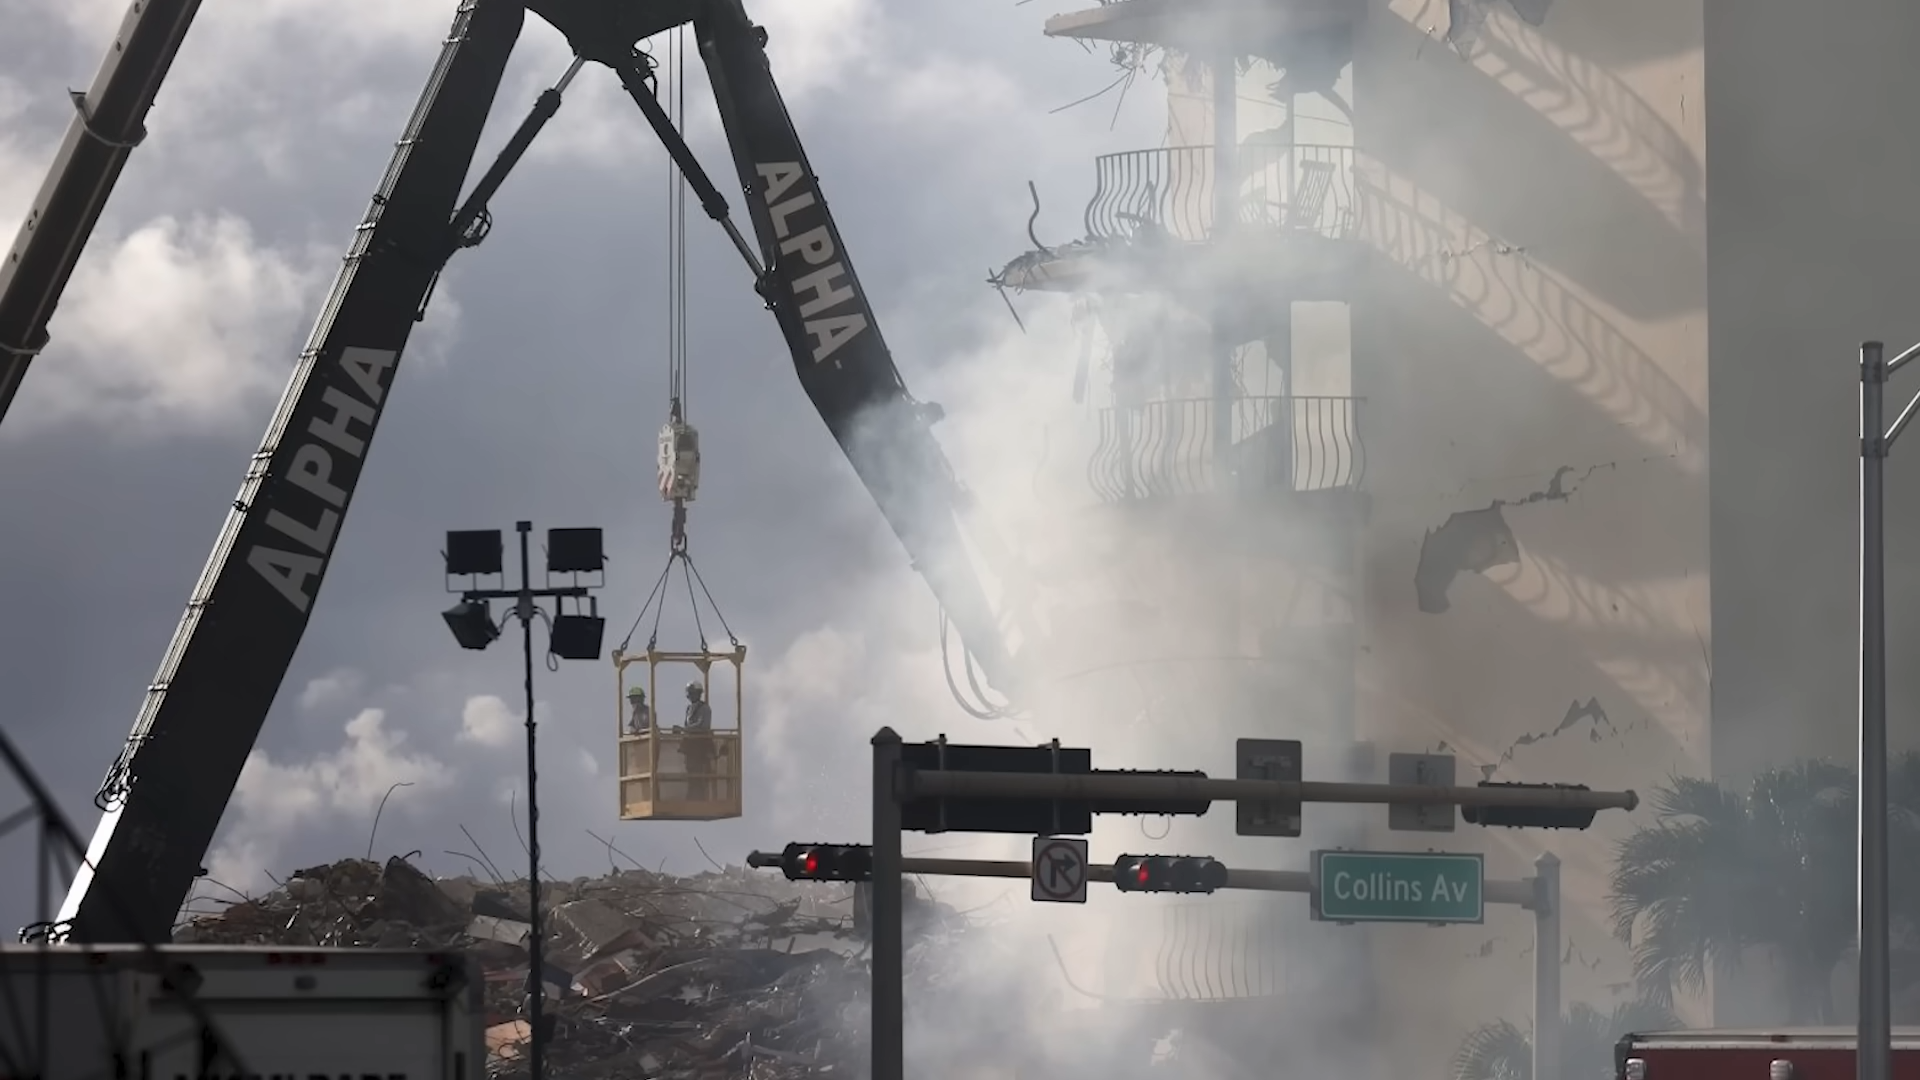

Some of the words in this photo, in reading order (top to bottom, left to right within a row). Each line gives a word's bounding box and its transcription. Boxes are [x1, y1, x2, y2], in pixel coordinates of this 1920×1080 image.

[755, 161, 867, 364] ALPHA
[247, 346, 397, 613] ALPHA
[1334, 871, 1422, 902] Collins
[1431, 873, 1468, 903] Av
